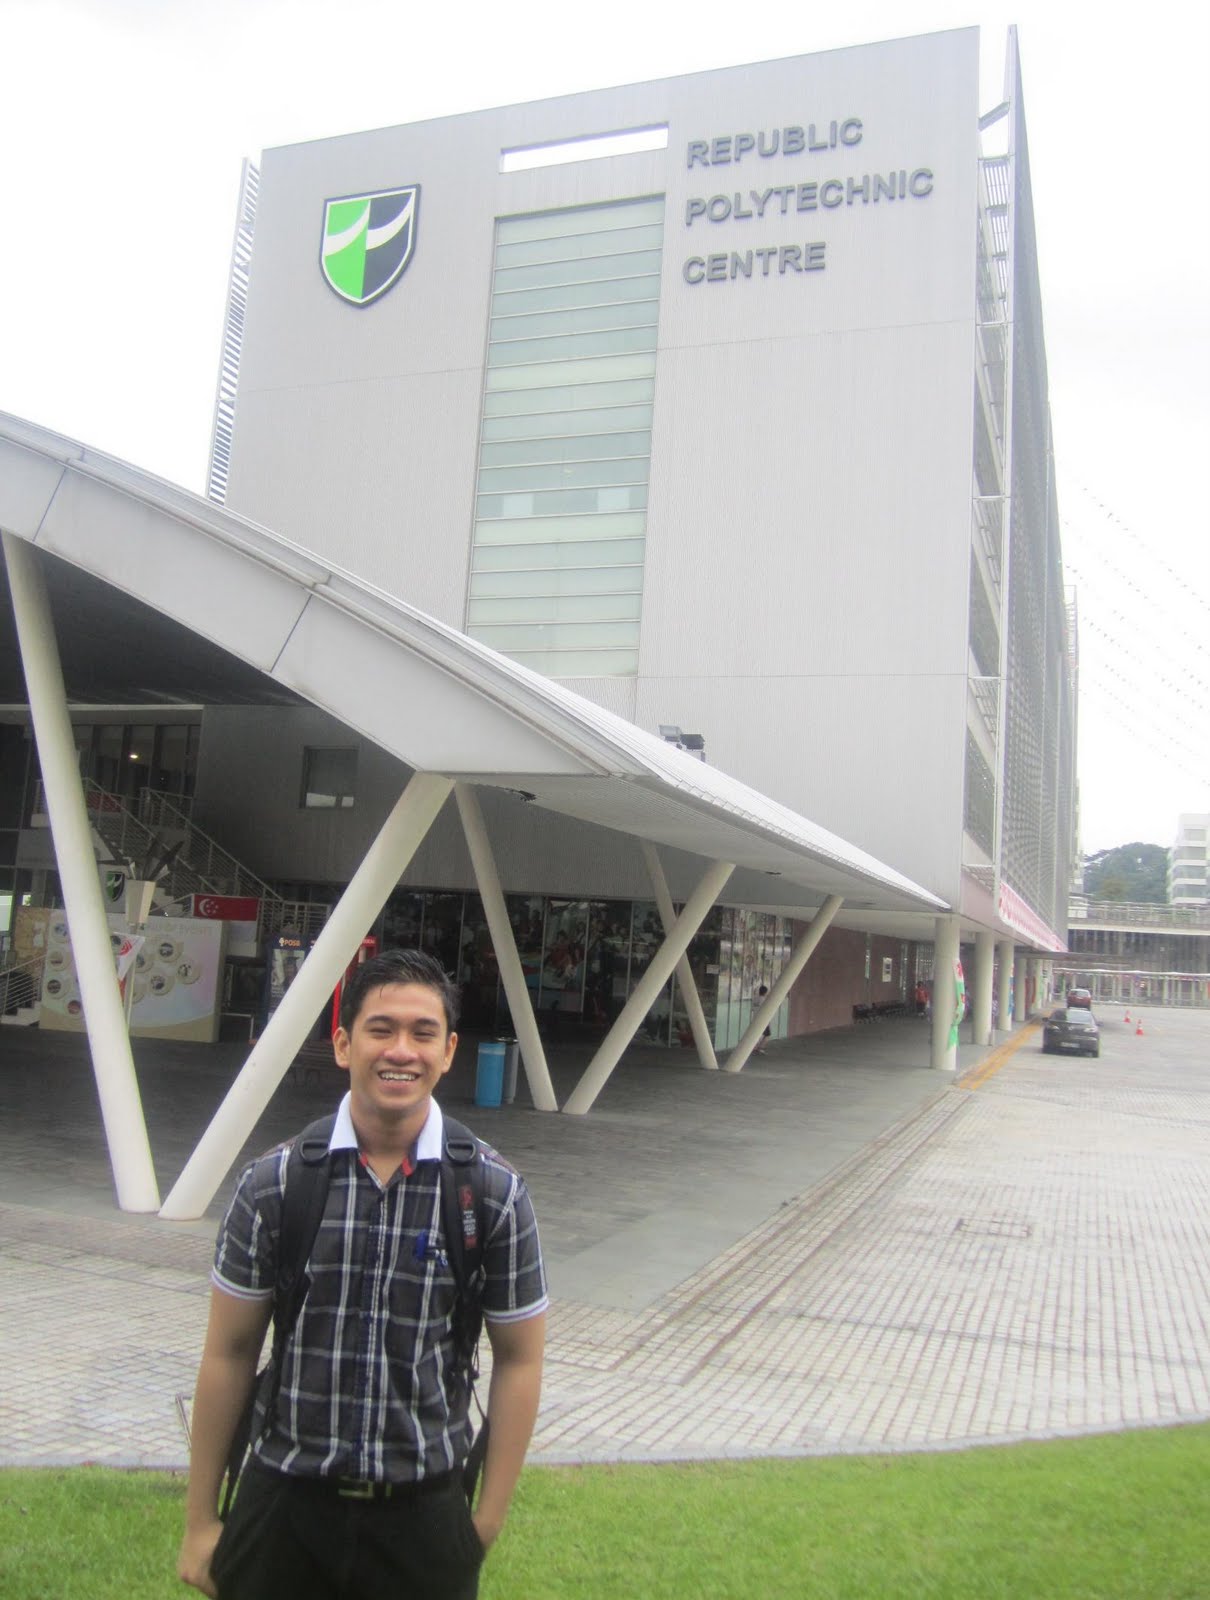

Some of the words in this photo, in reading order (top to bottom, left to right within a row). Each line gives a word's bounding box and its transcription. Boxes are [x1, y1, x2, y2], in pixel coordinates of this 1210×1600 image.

[687, 118, 863, 169] REPUBLIC
[685, 168, 934, 227] POLYTECHNIC
[683, 241, 827, 285] CENTRE
